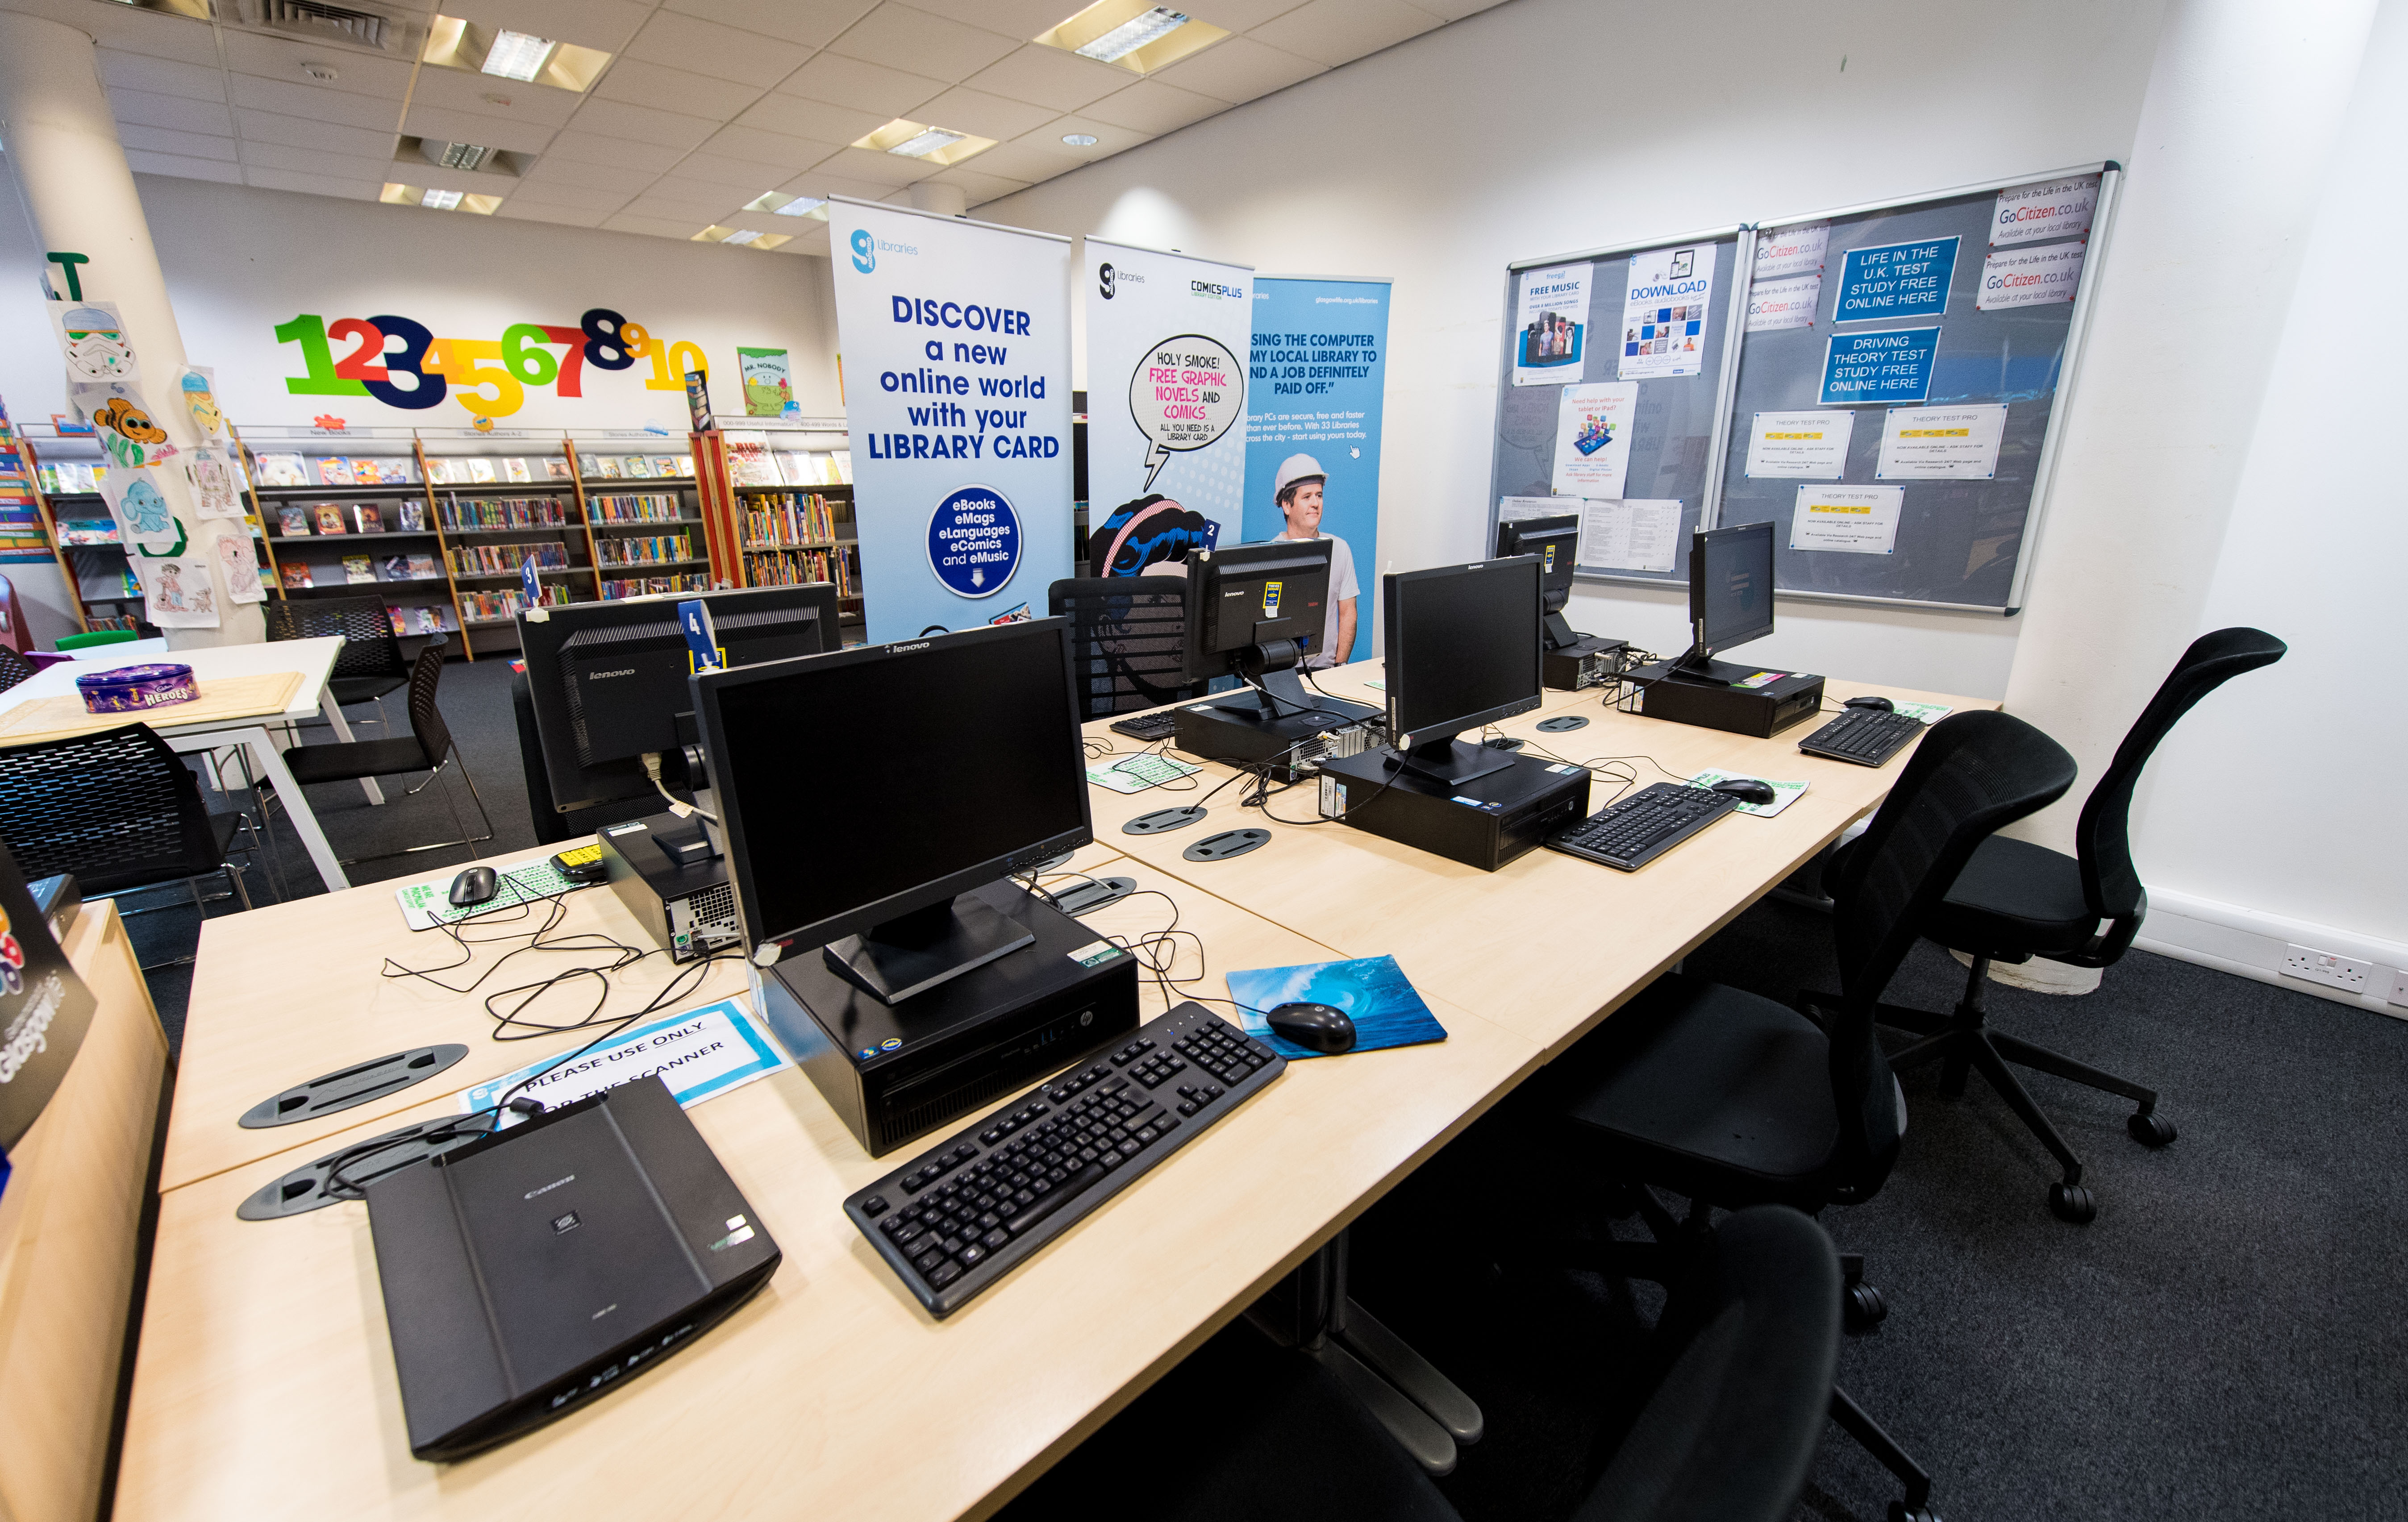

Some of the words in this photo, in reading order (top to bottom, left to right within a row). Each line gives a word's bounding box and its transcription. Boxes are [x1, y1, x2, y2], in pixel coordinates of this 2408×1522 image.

[1999, 194, 2020, 204] Prepare
[2042, 186, 2054, 195] Life
[2054, 185, 2060, 193] in
[2062, 183, 2071, 191] the
[2074, 180, 2085, 190] UK
[2085, 181, 2097, 189] test
[2000, 197, 2089, 224] GoCitizen.co.uk
[878, 239, 918, 255] libraries
[1757, 238, 1822, 260] GoCitizen.co.uk
[1860, 252, 1889, 266] LIFE
[1892, 250, 1908, 261] IN
[1911, 246, 1939, 259] THE
[1117, 270, 1145, 283] libraries
[1864, 267, 1889, 279] U.K.
[1894, 262, 1930, 276] TEST
[1987, 267, 2074, 289] GoCitizen.co.uk
[1191, 280, 1242, 298] COMICSPLUS
[1530, 285, 1549, 295] FREE
[1552, 281, 1580, 292] MUSIC
[1631, 280, 1707, 299] DOWNLOAD
[1850, 280, 1897, 295] STUDY
[1900, 276, 1938, 290] FREE
[1315, 296, 1378, 305] glasgowlife.org.uk/libraries
[1654, 295, 1689, 304] audiobooks
[1749, 296, 1812, 314] GoCitizen.co.uk
[1845, 295, 1895, 309] ONLINE
[1898, 291, 1938, 304] HERE
[892, 295, 1030, 336] DISCOVER
[1251, 333, 1281, 346] SING
[1284, 333, 1306, 346] THE
[1310, 334, 1374, 346] COMPUTER
[1853, 336, 1909, 349] DRIVING
[925, 340, 943, 361] a
[954, 342, 1007, 365] new
[1158, 352, 1181, 366] HOLY
[1185, 354, 1220, 369] SMOKE!
[1250, 350, 1267, 362] MY
[1270, 350, 1308, 362] LOCAL
[1312, 350, 1358, 362] LIBRARY
[1362, 350, 1376, 362] TO
[1834, 351, 1888, 365] THEORY
[1891, 349, 1927, 361] TEST
[757, 362, 785, 374] NOBODY
[1250, 366, 1267, 378] ND
[1270, 366, 1279, 378] A
[1281, 366, 1305, 378] JOB
[1308, 366, 1369, 378] DEFINITELY
[1834, 366, 1879, 378] STUDY
[1882, 364, 1919, 375] FREE
[880, 367, 969, 395] online
[979, 374, 1045, 399] world
[1149, 367, 1177, 383] FREE
[1181, 370, 1226, 386] GRAPHIC
[1830, 379, 1877, 391] ONLINE
[1880, 378, 1919, 389] HERE
[1155, 386, 1199, 402] NOVELS
[1202, 391, 1220, 403] AND
[1274, 382, 1302, 394] PAID
[908, 402, 965, 427] with
[975, 409, 1027, 433] your
[1264, 412, 1276, 420] PCs
[1278, 422, 1303, 430] before.
[1321, 421, 1330, 429] 33
[1332, 421, 1359, 429] Libraries
[1274, 433, 1286, 442] city
[1309, 432, 1325, 441] using
[1327, 432, 1345, 441] yours
[1346, 431, 1366, 440] today.
[868, 433, 984, 459] LIBRARY
[993, 435, 1059, 458] CARD
[952, 499, 996, 511] eBooks
[954, 512, 995, 526] eMags
[938, 525, 1010, 540] eLanguages
[1207, 524, 1214, 536] 2
[950, 538, 1001, 552] eComics
[943, 553, 966, 566] and
[970, 551, 1009, 564] eMusic
[525, 566, 532, 584] 3
[689, 612, 700, 634] 4
[893, 642, 929, 653] lenovo
[589, 669, 635, 679] lenovo
[144, 687, 188, 706] HEROES
[525, 1058, 602, 1092] PLEASE
[608, 1043, 647, 1061] USE
[653, 1022, 703, 1046] ONLY
[524, 1174, 575, 1199] Canon
